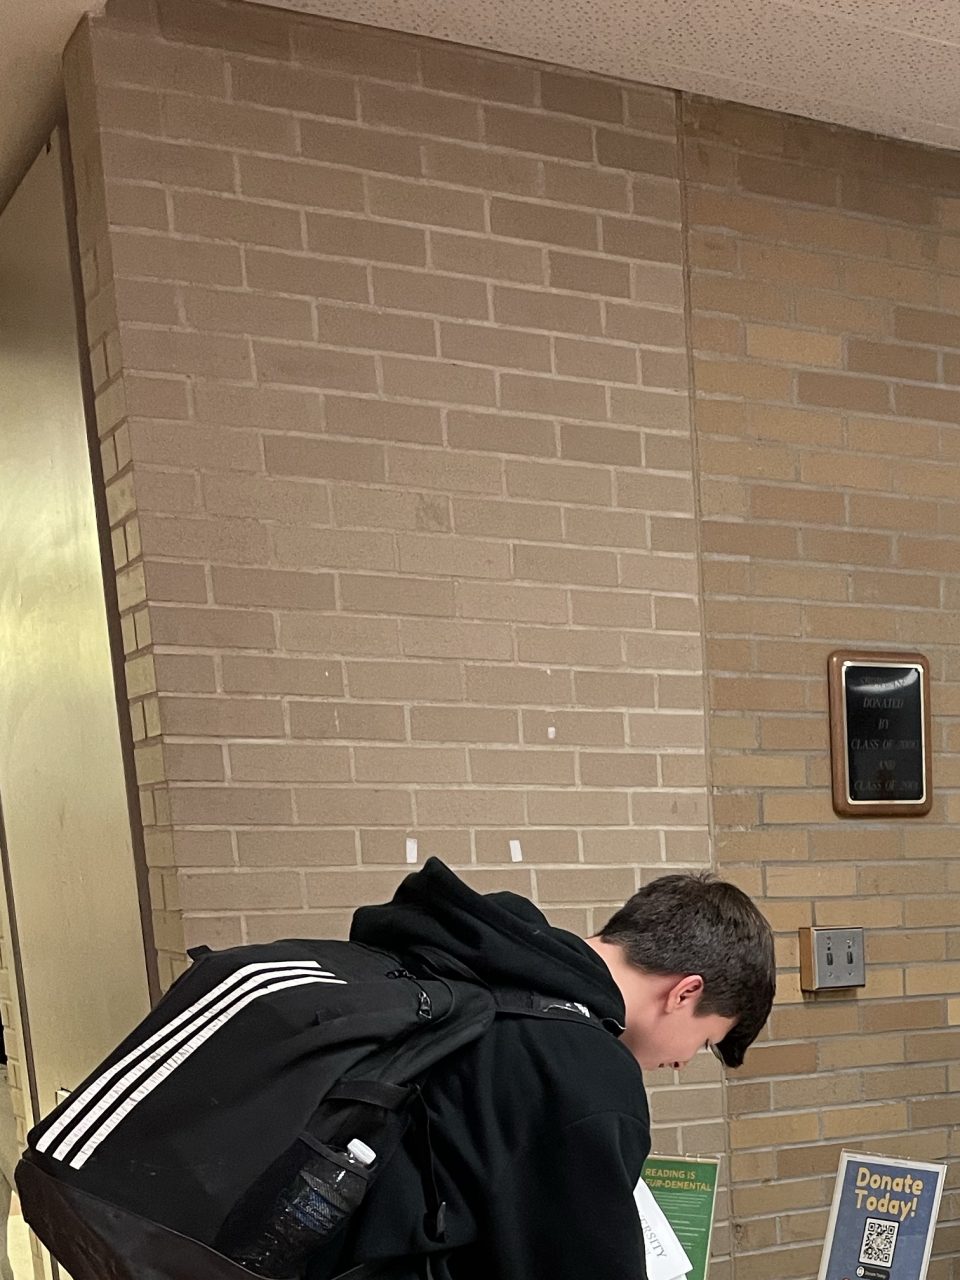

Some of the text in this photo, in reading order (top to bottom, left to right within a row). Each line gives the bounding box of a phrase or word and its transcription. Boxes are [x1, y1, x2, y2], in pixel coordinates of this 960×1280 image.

[645, 1168, 696, 1179] READING IS
[856, 1167, 924, 1195] Donate
[855, 1190, 918, 1222] Today!
